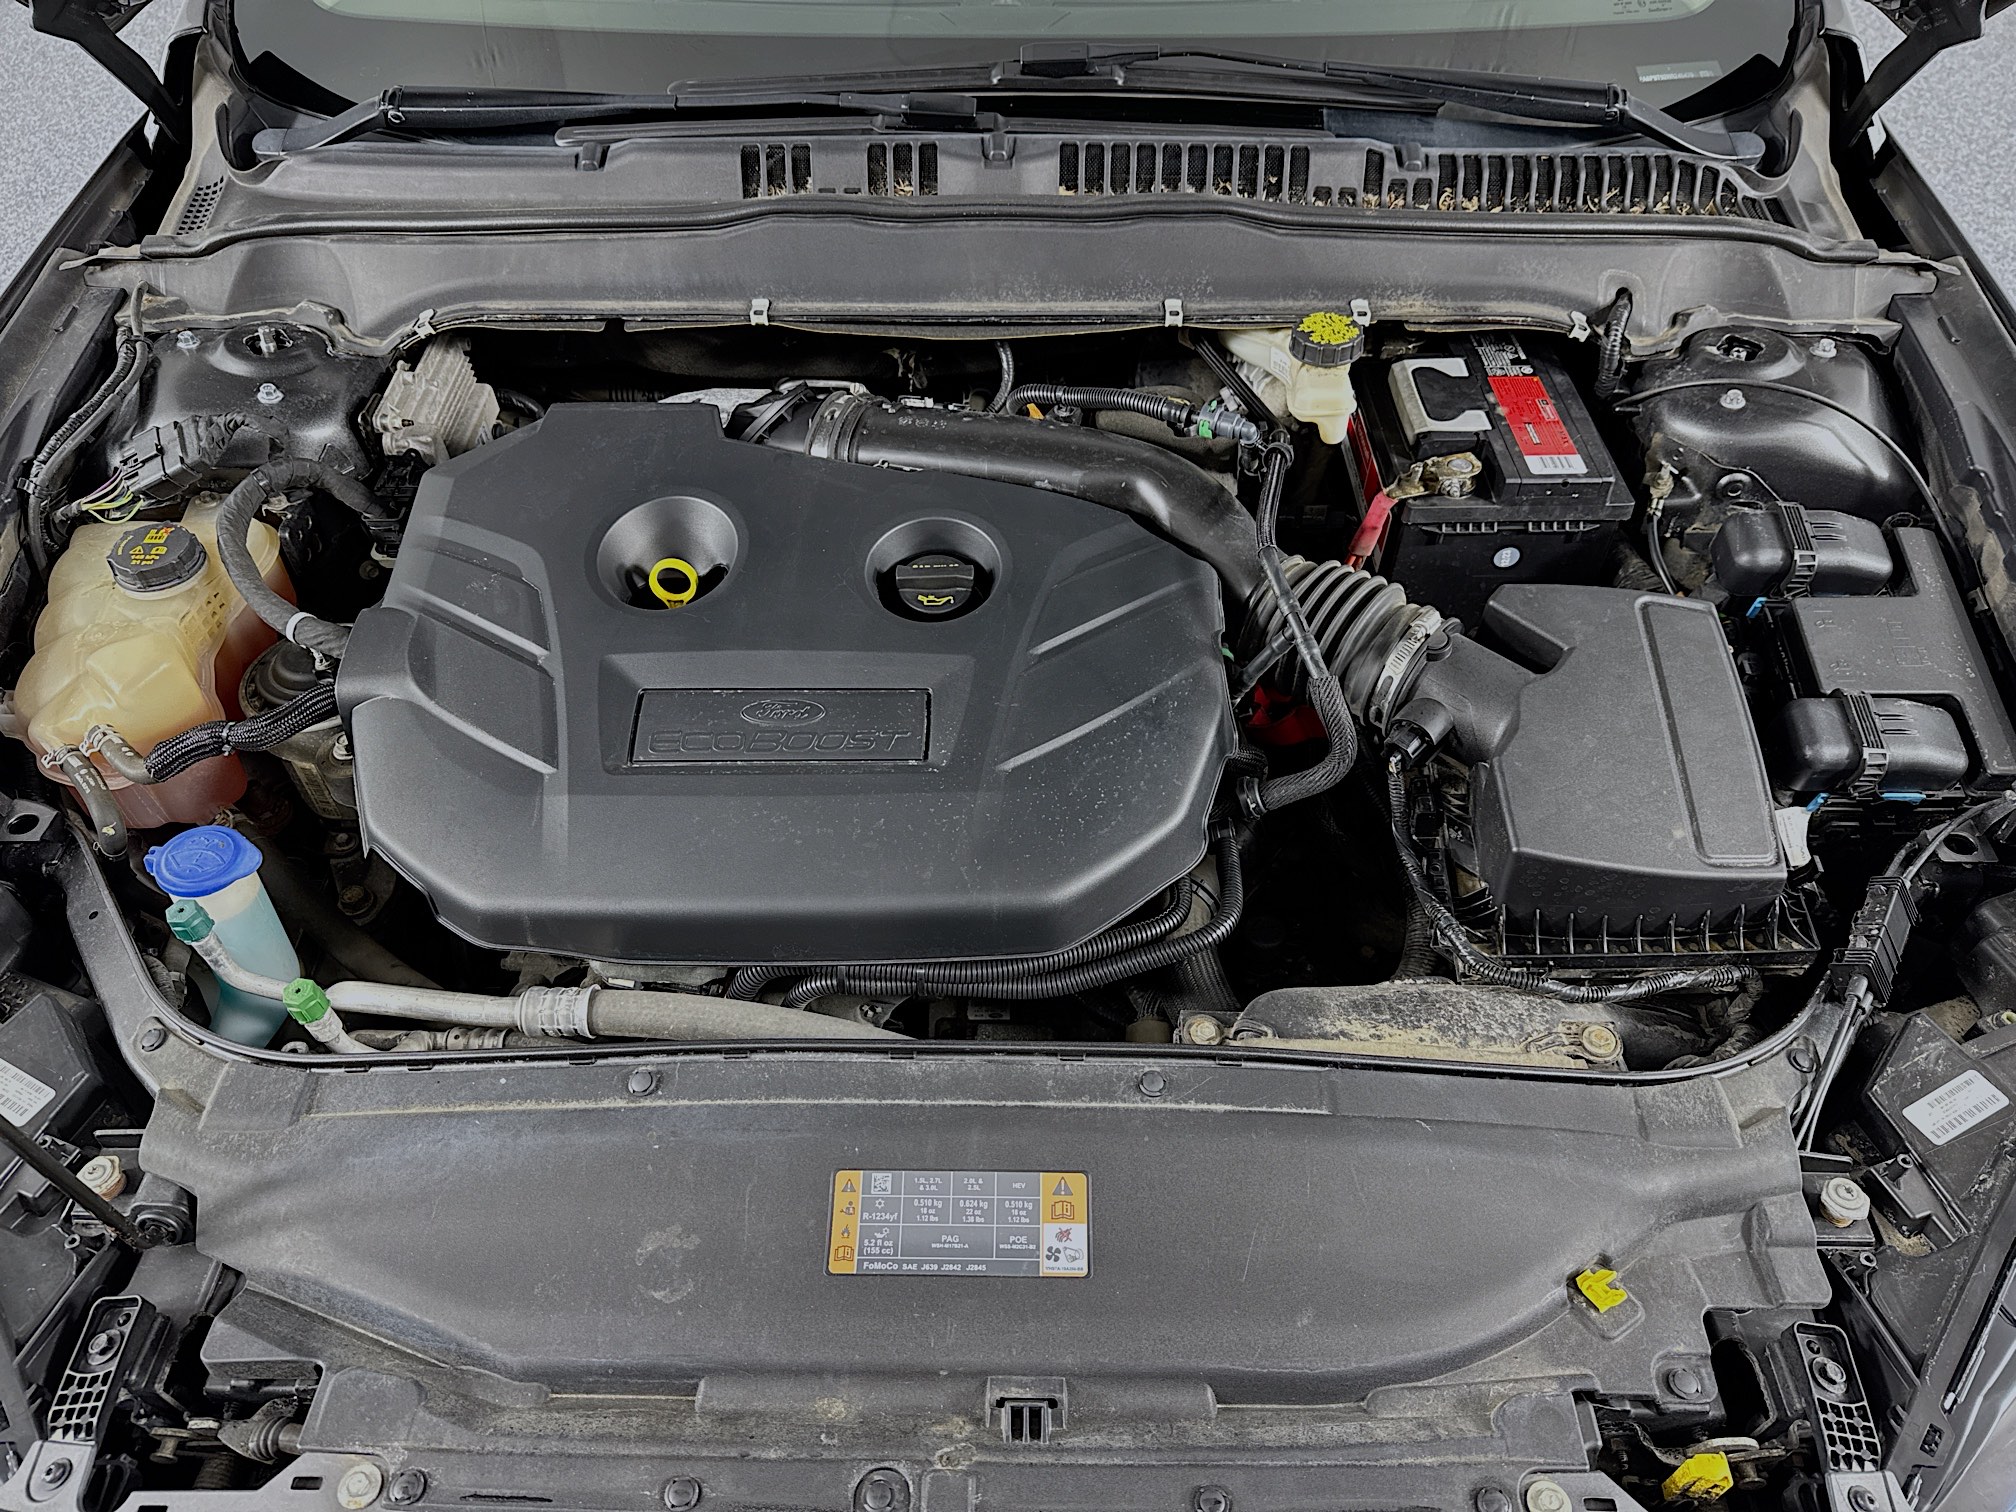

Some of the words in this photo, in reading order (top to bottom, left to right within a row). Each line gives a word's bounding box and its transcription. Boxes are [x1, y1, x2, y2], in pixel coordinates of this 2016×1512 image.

[756, 702, 808, 719] Ford
[648, 730, 912, 754] ECOBOOST
[934, 1199, 942, 1208] kg
[979, 1200, 988, 1209] kg
[1024, 1201, 1032, 1210] kg
[862, 1213, 898, 1222] R-1234yf
[864, 1247, 880, 1255] (155
[863, 1262, 898, 1270] FoMoCo
